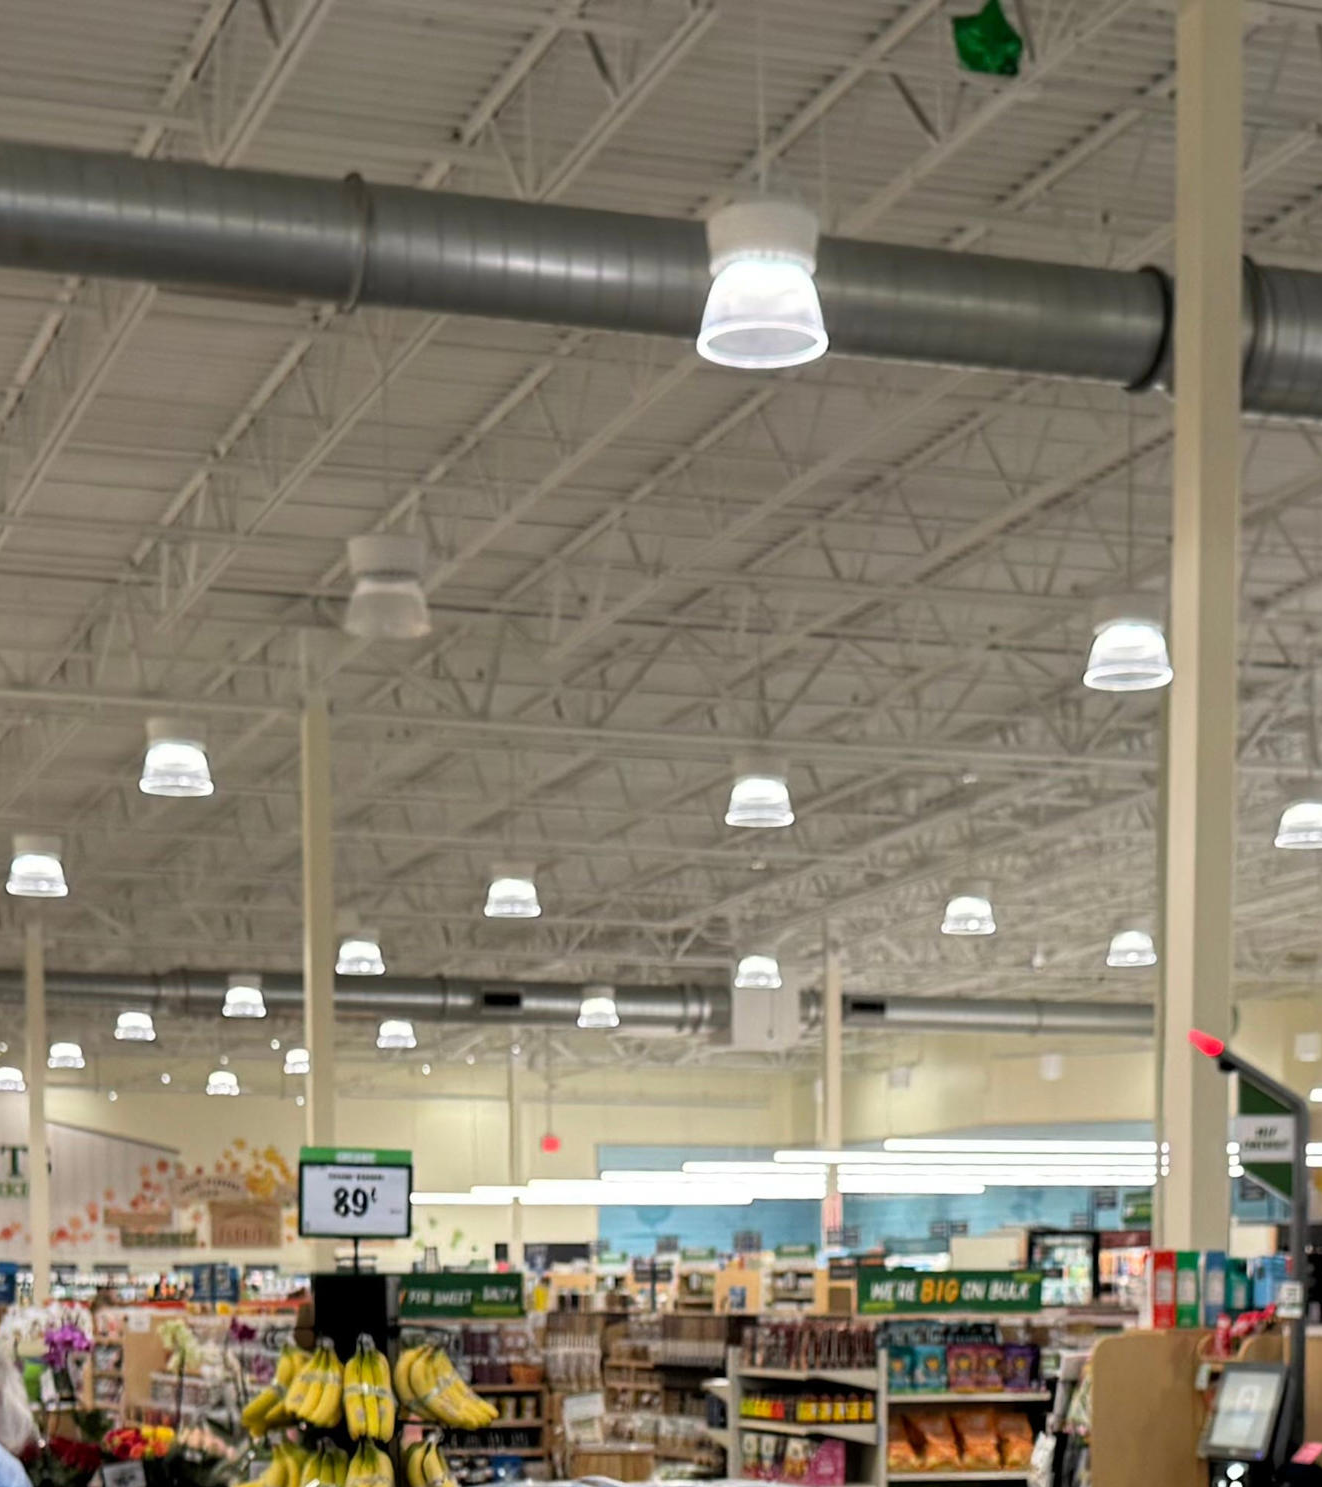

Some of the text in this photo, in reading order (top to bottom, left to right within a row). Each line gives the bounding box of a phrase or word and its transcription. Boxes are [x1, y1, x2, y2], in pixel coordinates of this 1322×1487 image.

[919, 1277, 960, 1304] BIG
[960, 1280, 988, 1301] ON
[988, 1280, 1032, 1301] BULK
